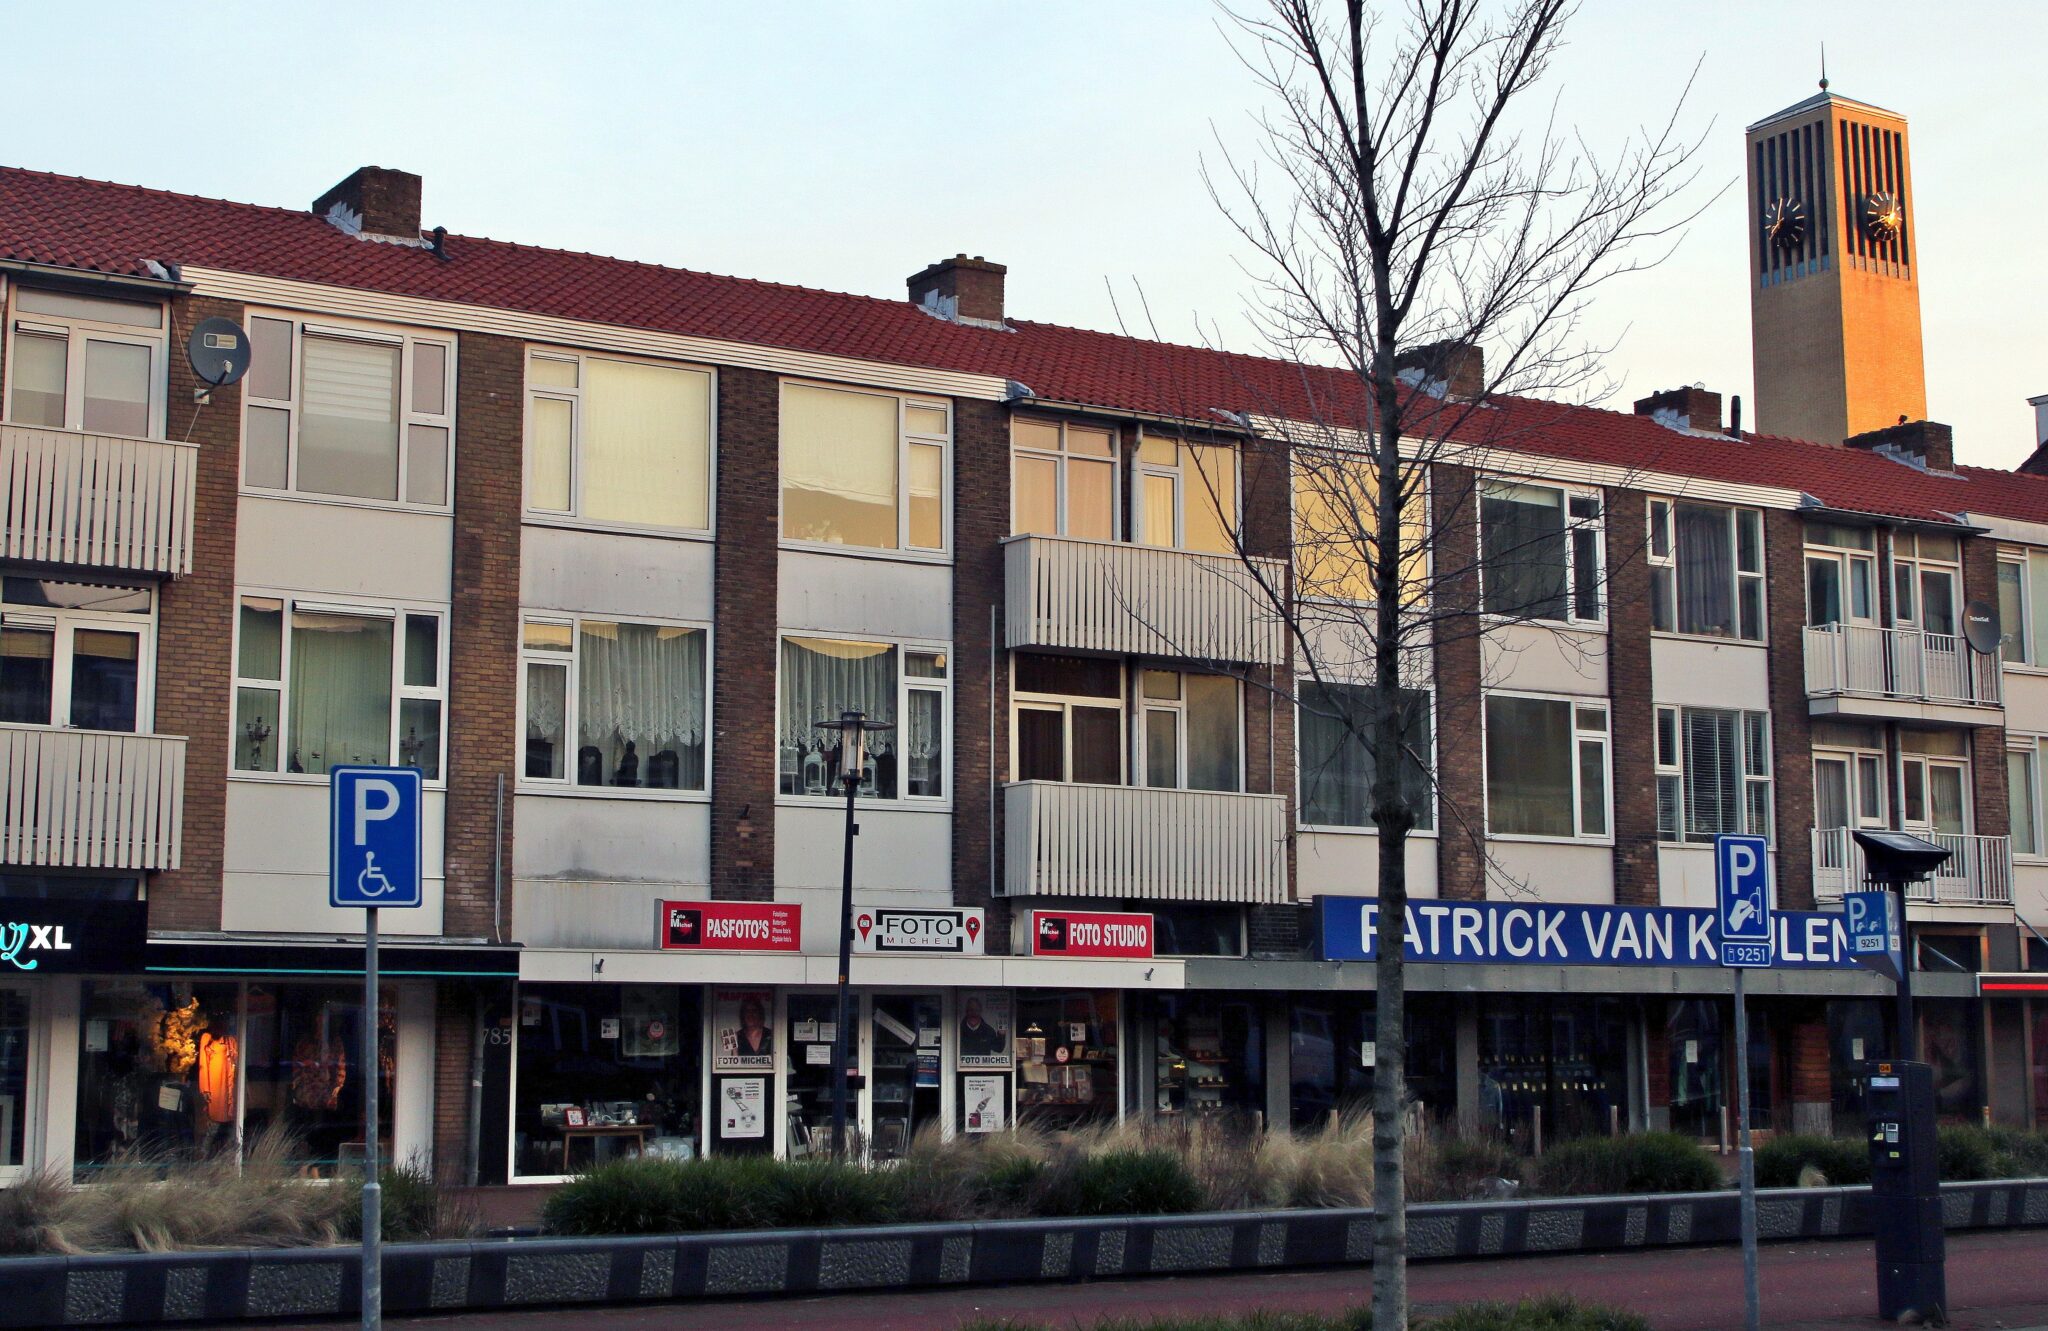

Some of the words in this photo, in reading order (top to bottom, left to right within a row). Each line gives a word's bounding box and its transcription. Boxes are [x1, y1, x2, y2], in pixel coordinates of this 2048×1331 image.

[355, 779, 400, 845] P
[1729, 844, 1756, 895] P
[1848, 897, 1867, 933] P
[706, 919, 769, 938] PASFOTO'S
[886, 918, 953, 935] FOTO
[1069, 923, 1100, 946] FOTO
[1103, 924, 1147, 948] STUDIO
[886, 937, 953, 945] MICHEL
[1581, 911, 1672, 960] VAN
[1689, 914, 1857, 963] KLEN
[1860, 938, 1880, 948] 9251
[1737, 947, 1766, 962] 9251
[718, 1057, 739, 1065] FOTO
[740, 1057, 771, 1065] MICHEL
[961, 1056, 980, 1064] FOTO
[981, 1056, 1009, 1064] MICHEL
